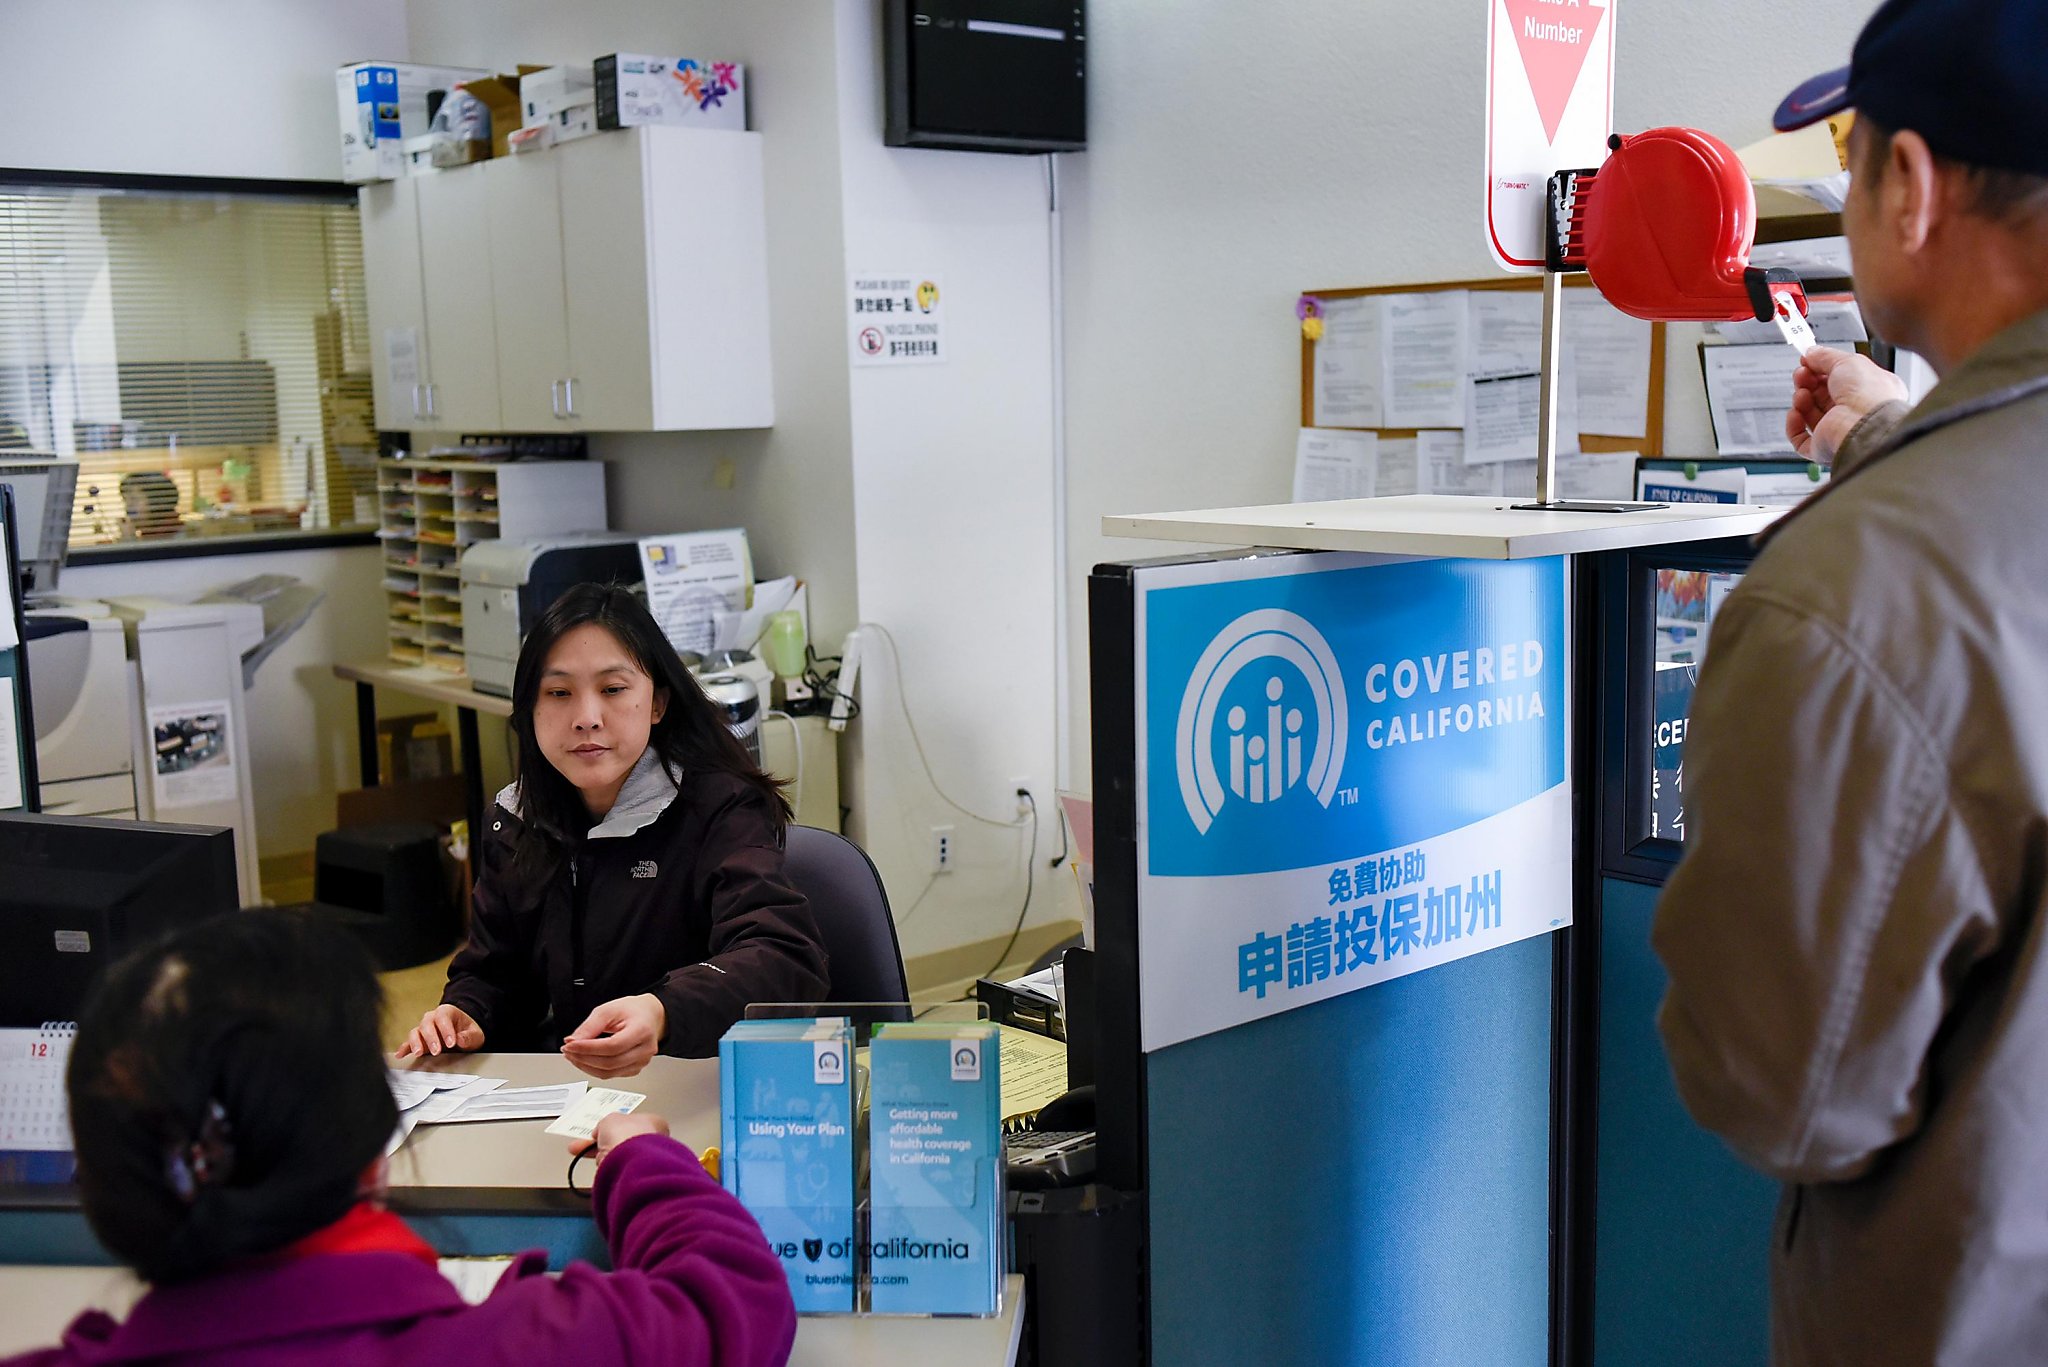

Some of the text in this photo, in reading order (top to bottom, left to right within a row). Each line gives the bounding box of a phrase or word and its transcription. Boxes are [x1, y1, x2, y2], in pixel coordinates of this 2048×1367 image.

[1524, 16, 1583, 44] Number
[1671, 491, 1681, 502] OF
[1365, 640, 1544, 703] COVERED
[1366, 691, 1545, 750] CALIFORNIA
[1338, 787, 1359, 806] TM
[1328, 849, 1426, 906] 免費协助
[1238, 869, 1501, 999] 申請投保加州
[31, 1043, 48, 1057] 12
[889, 1108, 959, 1122] Getting more
[749, 1122, 845, 1138] Using Your Plan
[889, 1122, 943, 1135] affordable
[889, 1137, 972, 1152] health coverage
[889, 1152, 950, 1164] in California
[768, 1237, 969, 1259] ue of alifornia
